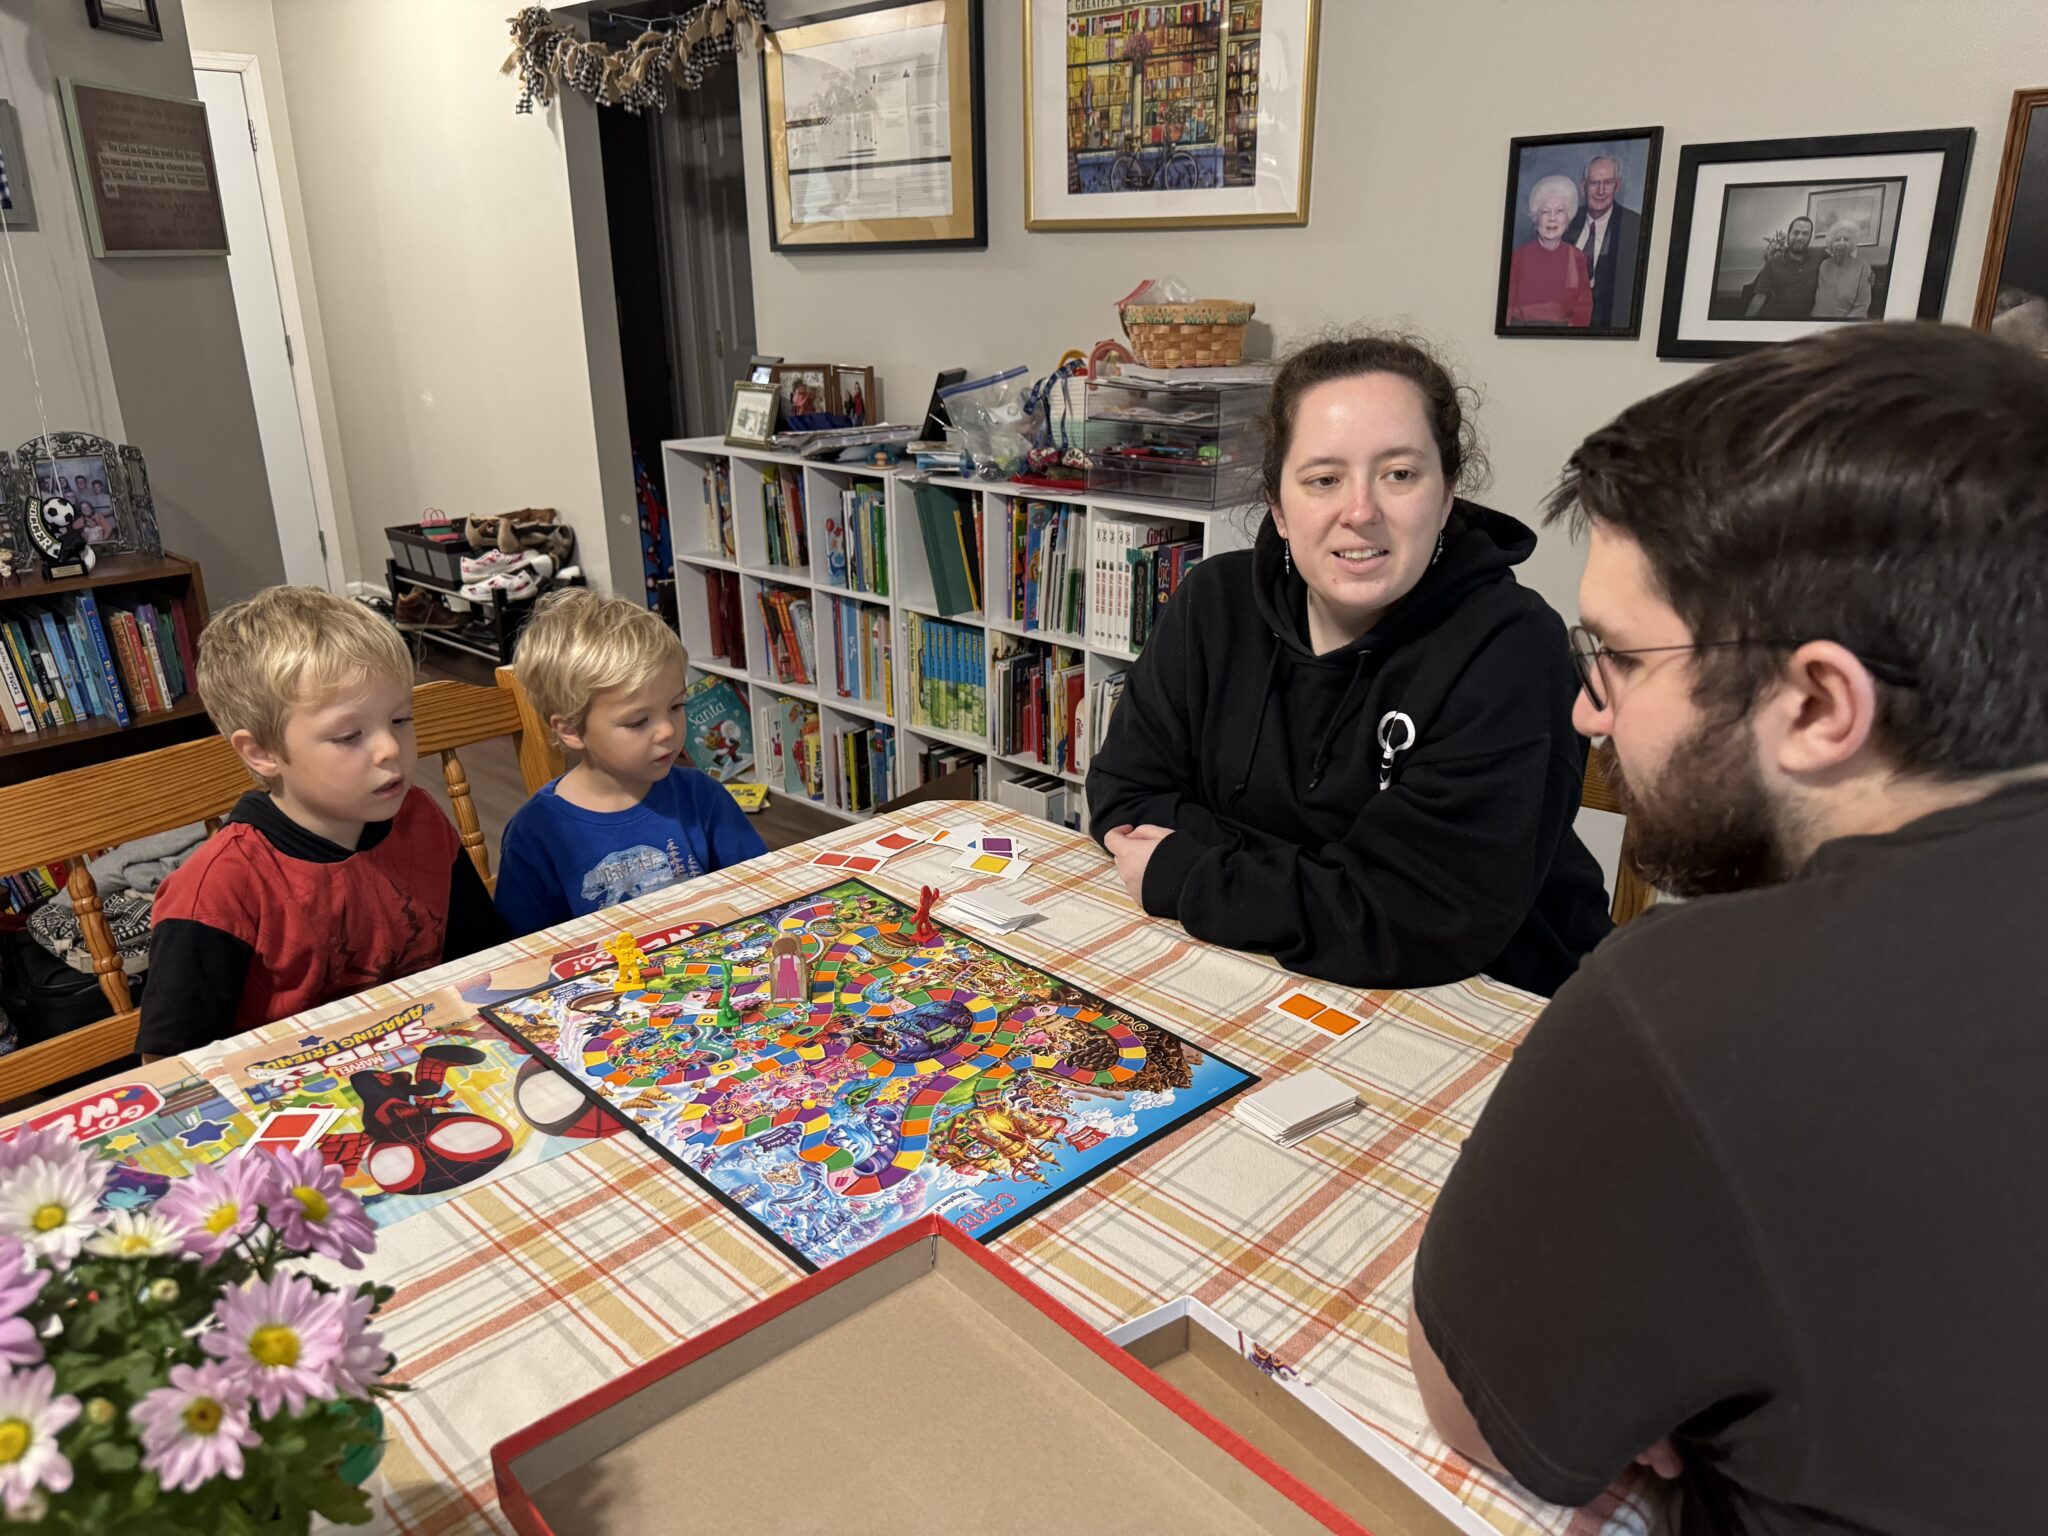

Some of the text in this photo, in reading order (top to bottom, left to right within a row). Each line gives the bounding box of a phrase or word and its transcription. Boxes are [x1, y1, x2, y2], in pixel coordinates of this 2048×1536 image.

[29, 499, 53, 550] SOCCER
[1135, 565, 1145, 642] DINOSAUR
[7, 671, 21, 695] TRUCKS
[688, 701, 727, 729] Santa
[246, 1003, 424, 1073] AMAZING FRIEND
[272, 1019, 432, 1087] SPIDEY
[338, 1053, 386, 1076] MARVEL
[934, 1191, 968, 1213] Kingdom of
